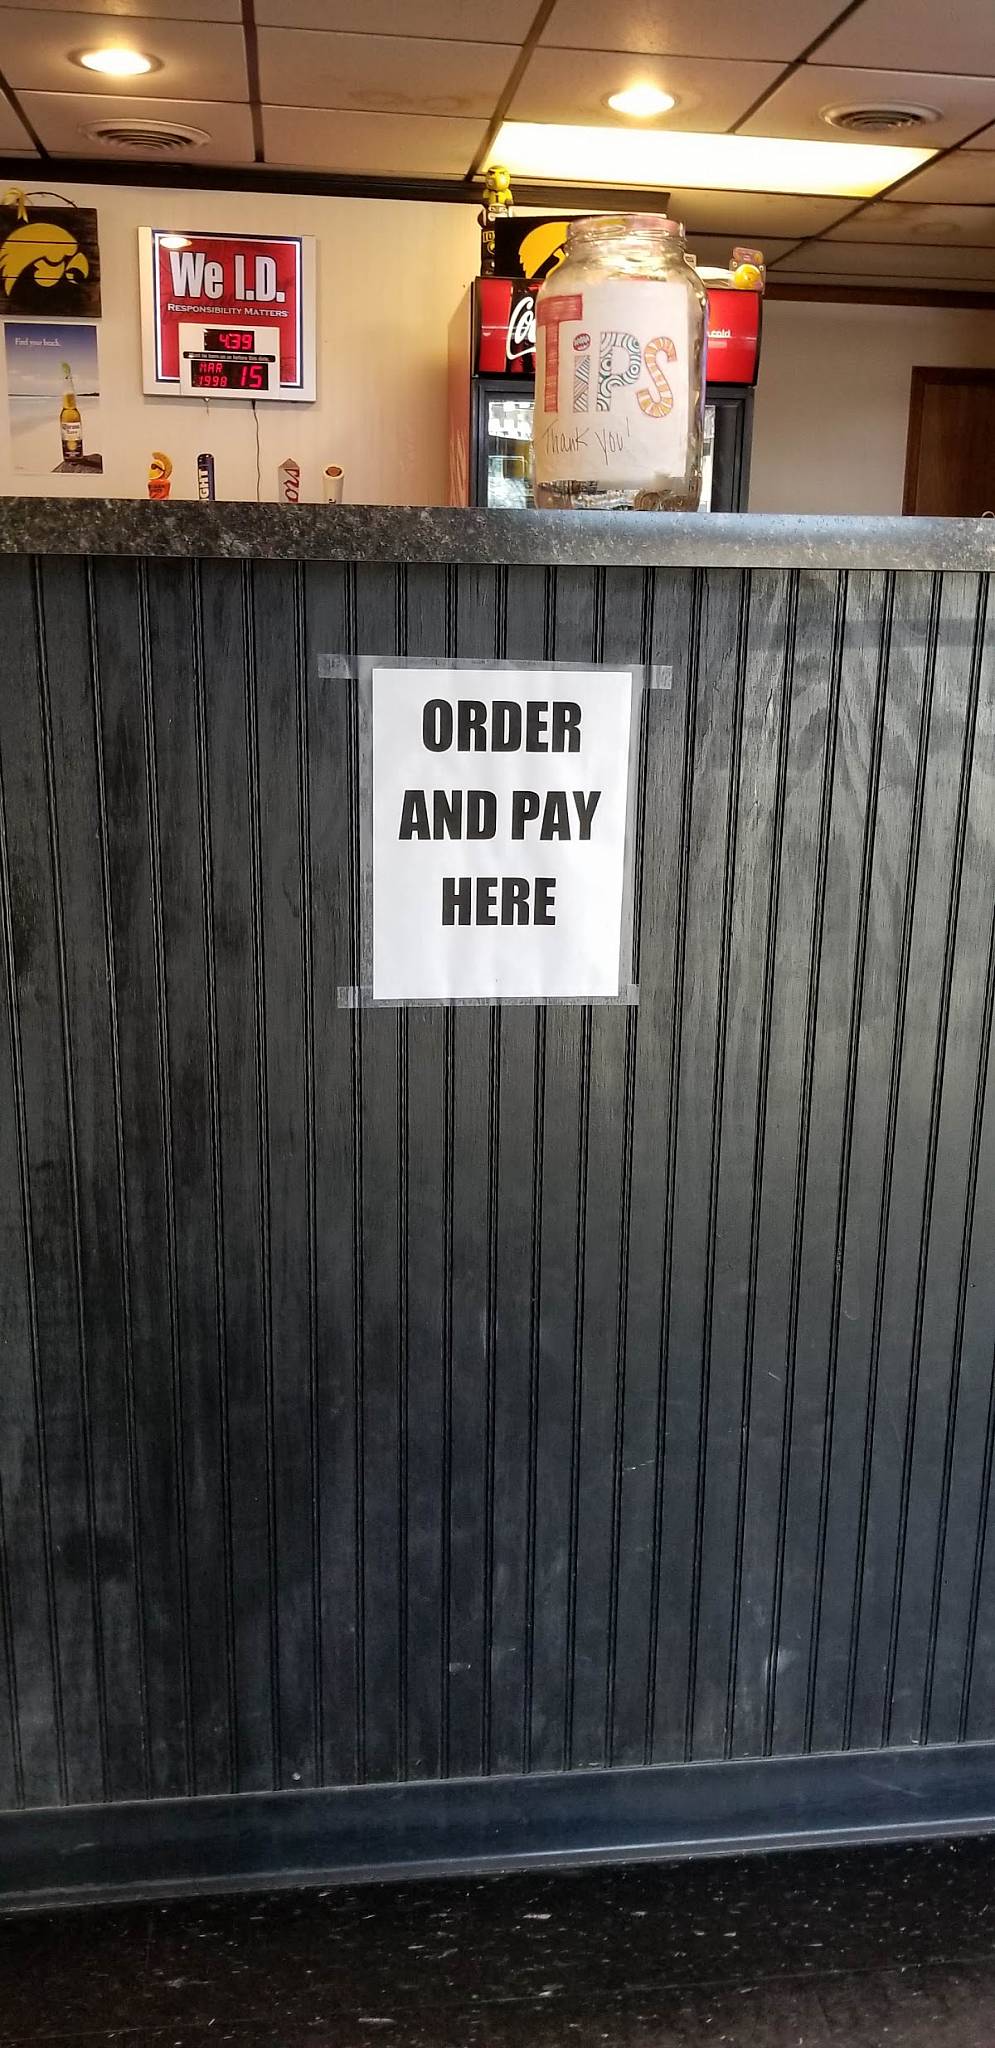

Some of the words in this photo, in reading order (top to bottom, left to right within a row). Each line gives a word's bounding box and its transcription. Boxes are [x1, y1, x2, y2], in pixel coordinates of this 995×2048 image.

[169, 251, 223, 299] We
[234, 254, 286, 303] I.D.
[240, 365, 264, 389] 15
[541, 419, 590, 456] Thank
[199, 468, 210, 500] GHT
[422, 698, 583, 753] ORDER
[398, 789, 498, 841] AND
[511, 789, 603, 841] PAY
[441, 876, 557, 926] HERE
